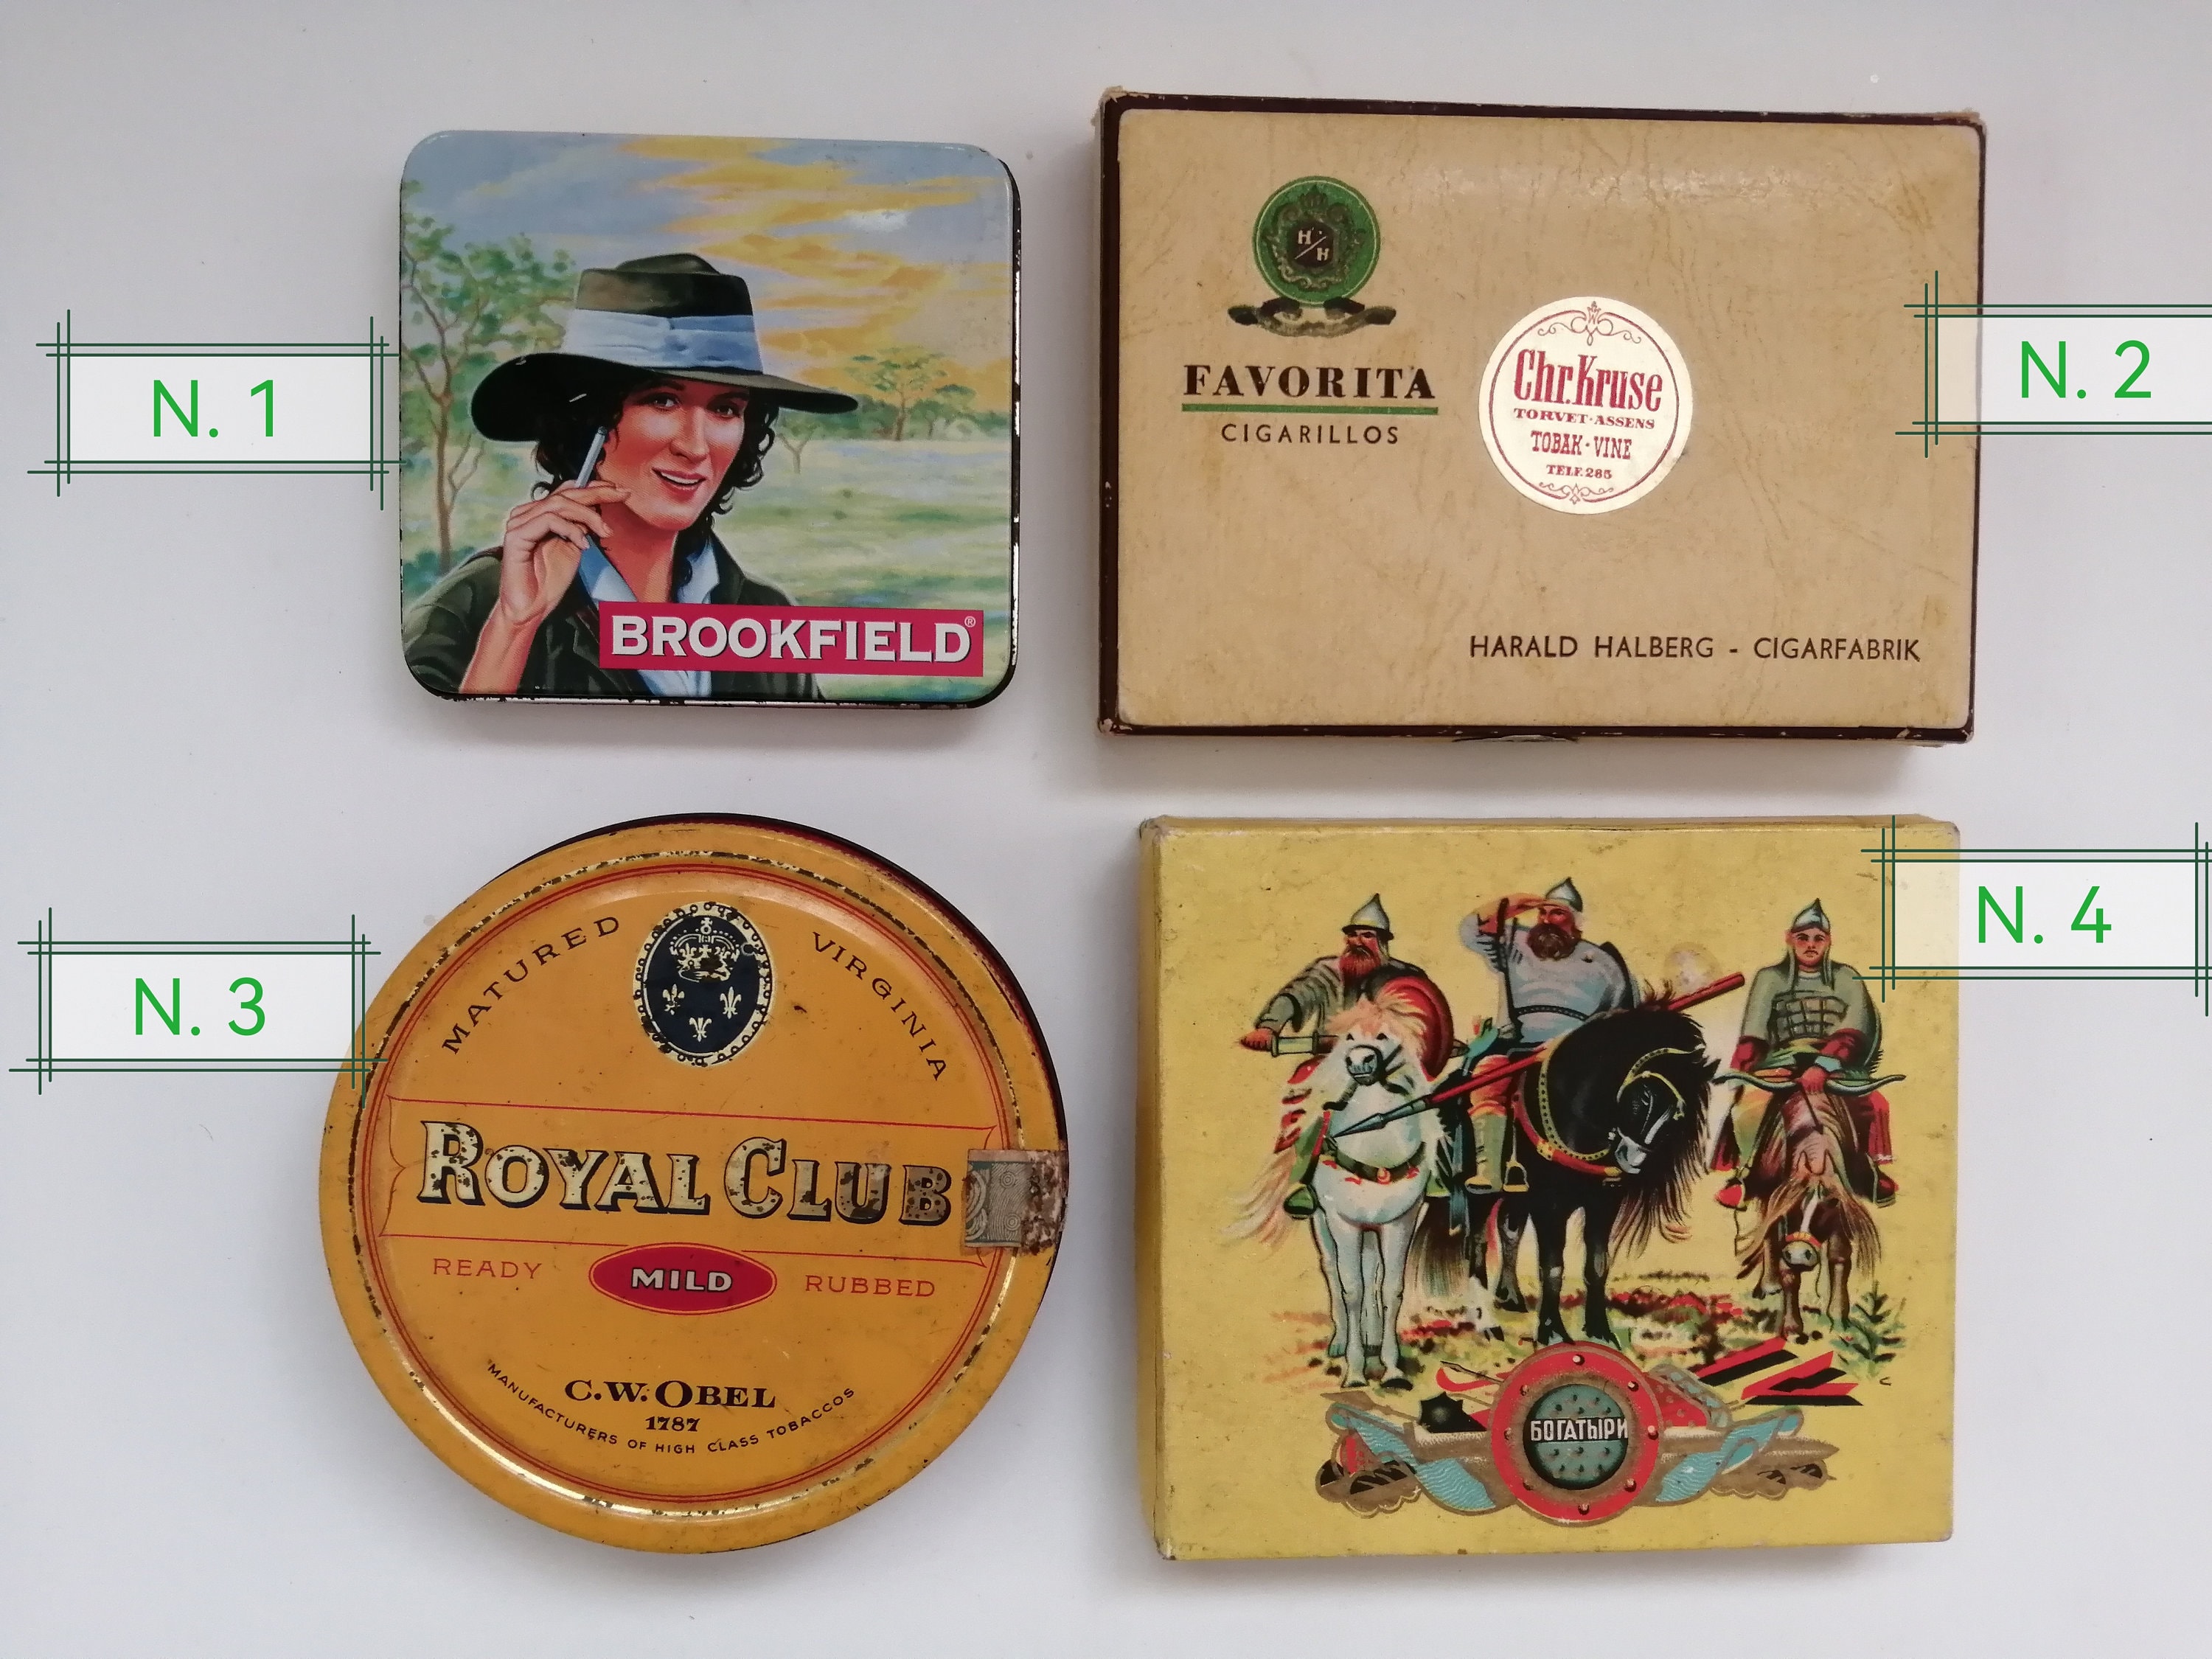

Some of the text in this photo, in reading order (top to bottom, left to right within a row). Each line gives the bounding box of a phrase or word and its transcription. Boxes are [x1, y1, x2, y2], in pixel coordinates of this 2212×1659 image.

[1183, 364, 1436, 399] FAVORITA
[1221, 422, 1398, 445] CIGARILLOS
[1531, 430, 1632, 459] TOBAK VINE
[1470, 635, 1578, 658] HARALD
[1594, 636, 1714, 658] HALBERG
[1753, 637, 1921, 662] CIGARFABRIK
[442, 917, 947, 1081] MATURED VIRGINIA
[417, 1121, 952, 1226] ROYAL CLUB
[433, 1258, 543, 1280] READY
[630, 1267, 732, 1293] MILD
[804, 1274, 936, 1298] RUBBED
[487, 1363, 855, 1455] MANUFACTURERS OF HIGH CLASS TOBACCOS
[645, 1416, 700, 1433] 1787
[1530, 1418, 1629, 1442] БОГАТЫРИ
